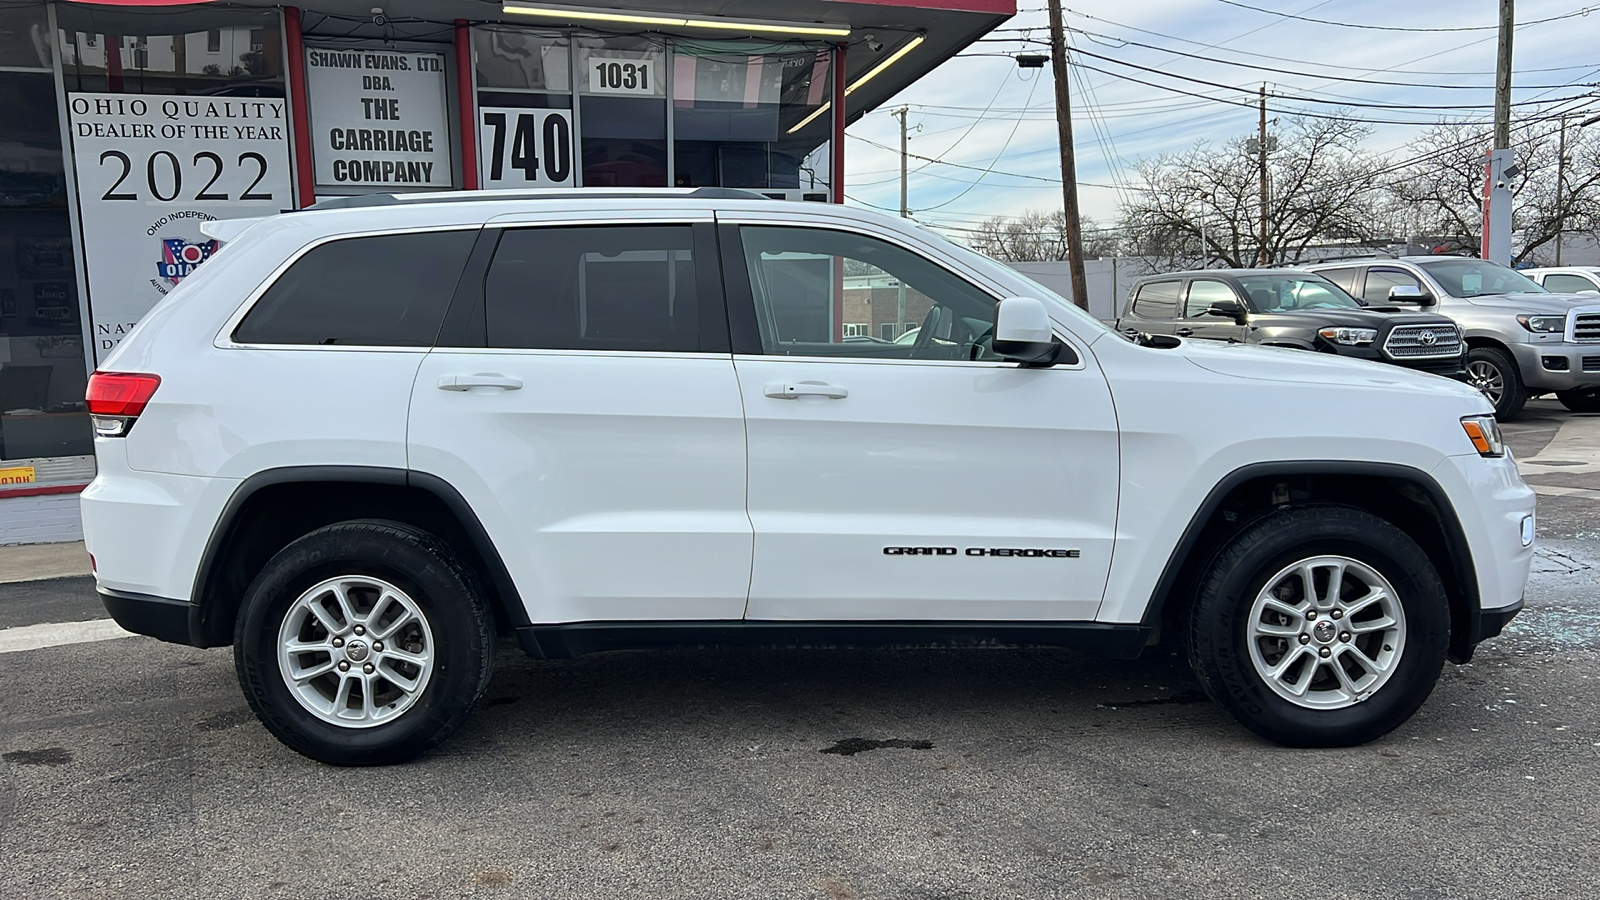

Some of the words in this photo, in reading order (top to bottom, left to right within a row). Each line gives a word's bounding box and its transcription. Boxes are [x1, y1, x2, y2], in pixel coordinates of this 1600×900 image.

[309, 51, 362, 69] SHAWN
[365, 54, 412, 72] EVANS.
[417, 57, 443, 73] LTD.
[362, 75, 395, 91] DBA.
[596, 62, 648, 90] 1031
[72, 98, 147, 116] OHIO
[162, 100, 283, 120] QUALITY
[361, 97, 400, 121] THE
[77, 122, 156, 138] DEALER
[161, 124, 186, 139] OF
[191, 125, 229, 140] THE
[233, 126, 283, 140] YEAR
[330, 128, 433, 152] CARRIAGE
[484, 112, 571, 183] 740
[99, 150, 273, 202] 2022
[333, 160, 433, 183] COMPANY
[147, 217, 168, 236] OHIO
[166, 263, 200, 276] OIA
[883, 546, 957, 556] GRAND
[965, 547, 1080, 558] CHEROKEE
